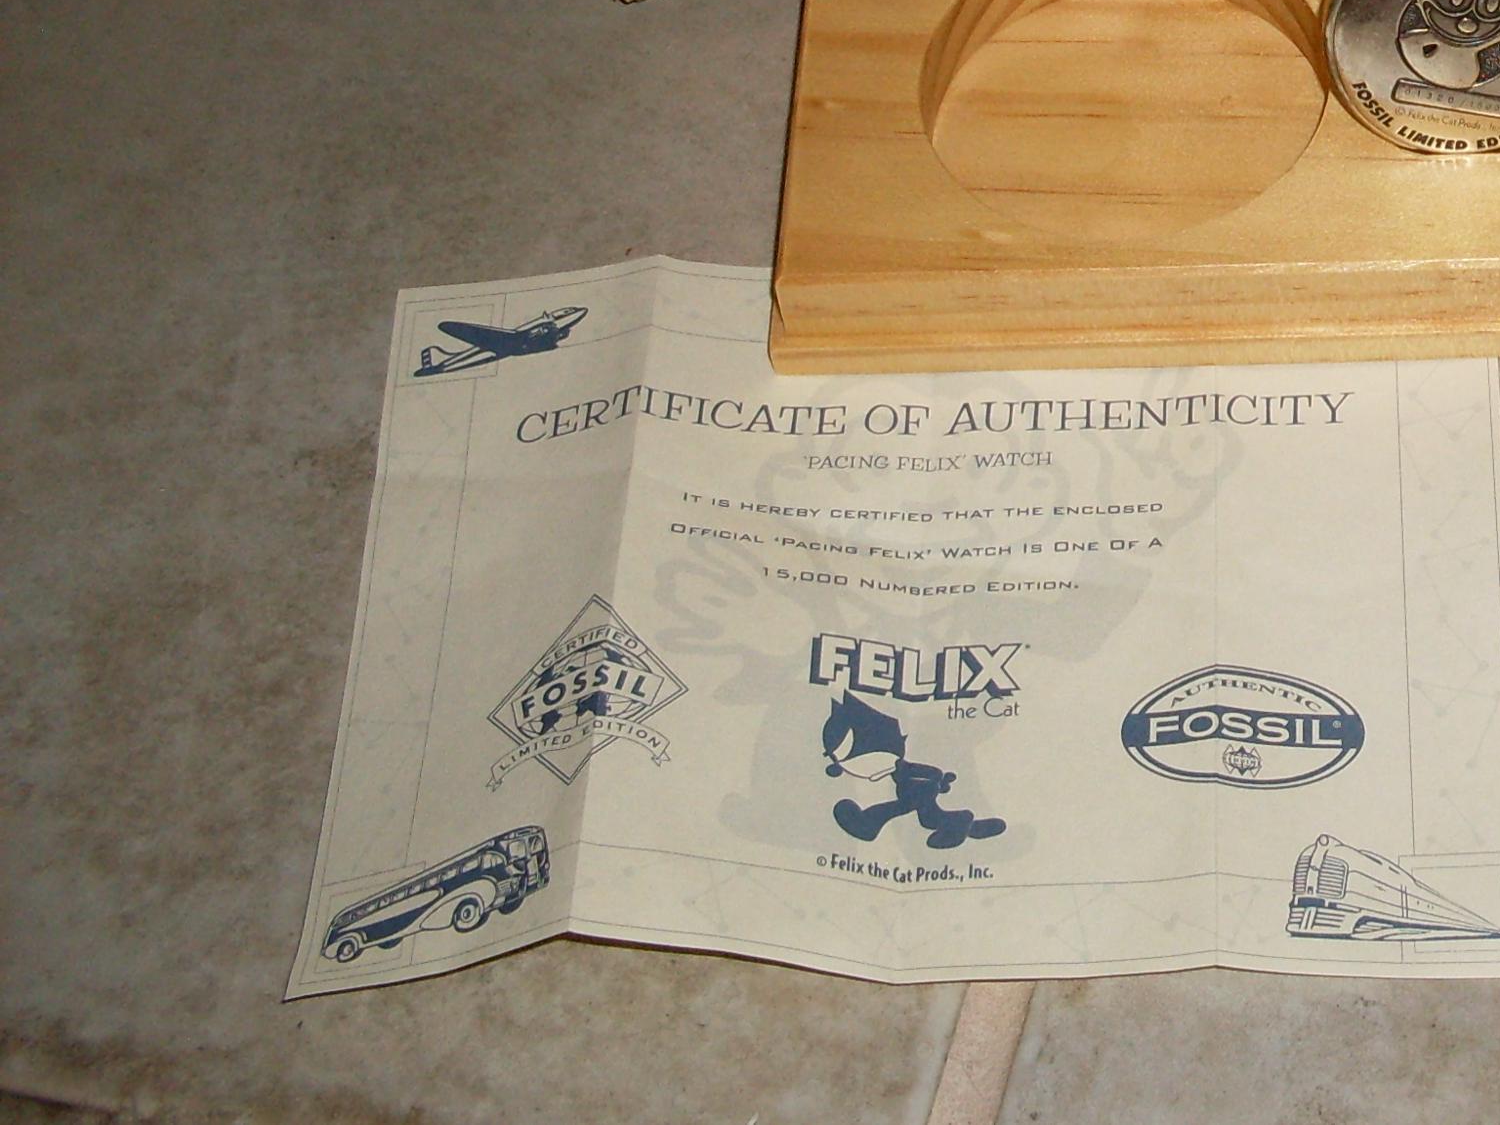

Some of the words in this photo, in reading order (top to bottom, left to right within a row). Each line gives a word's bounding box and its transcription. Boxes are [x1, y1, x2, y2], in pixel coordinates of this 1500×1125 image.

[1352, 81, 1393, 127] FOSSIL
[1397, 125, 1468, 151] LIMITED
[516, 385, 847, 443] CERTIFICATE
[864, 404, 930, 436] OF
[943, 391, 1356, 436] AUTHENTICITY
[974, 451, 1053, 469] WATCH
[1148, 536, 1164, 549] A
[761, 566, 849, 587] 15,000
[541, 627, 639, 669] CERTIFIED
[809, 633, 1022, 702] FELIX
[521, 664, 646, 718] FOSSIL
[946, 696, 977, 719] the
[983, 696, 1020, 718] Cat
[1170, 678, 1322, 712] AUTHENTIC
[499, 734, 572, 771] LIMITED
[582, 719, 662, 749] EDITION
[1148, 711, 1343, 746] FOSSIL
[830, 853, 864, 875] Felix
[868, 862, 890, 880] the
[893, 866, 913, 883] Cat
[916, 864, 965, 883] Prods.,
[969, 864, 994, 879] Inc.
